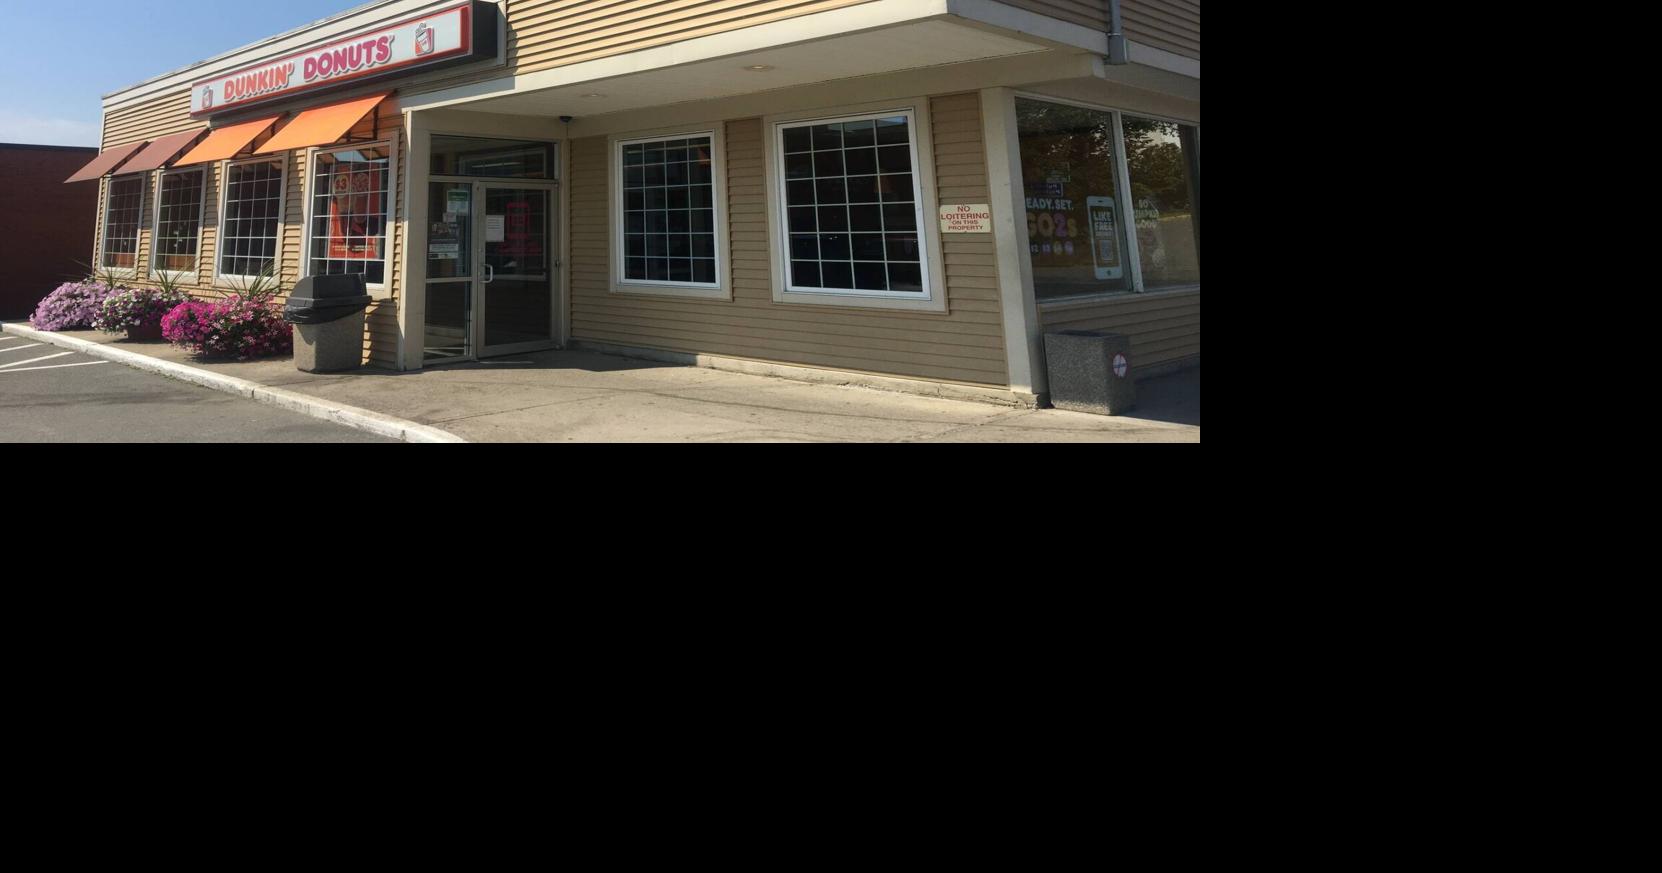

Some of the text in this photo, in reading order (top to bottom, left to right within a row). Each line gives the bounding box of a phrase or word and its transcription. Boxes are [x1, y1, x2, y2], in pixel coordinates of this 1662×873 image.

[224, 36, 392, 101] DUNKIN' DONUTS
[957, 205, 971, 213] NO
[1026, 198, 1054, 210] EADY.
[940, 212, 990, 220] LOITERING
[1093, 210, 1112, 221] LIKE
